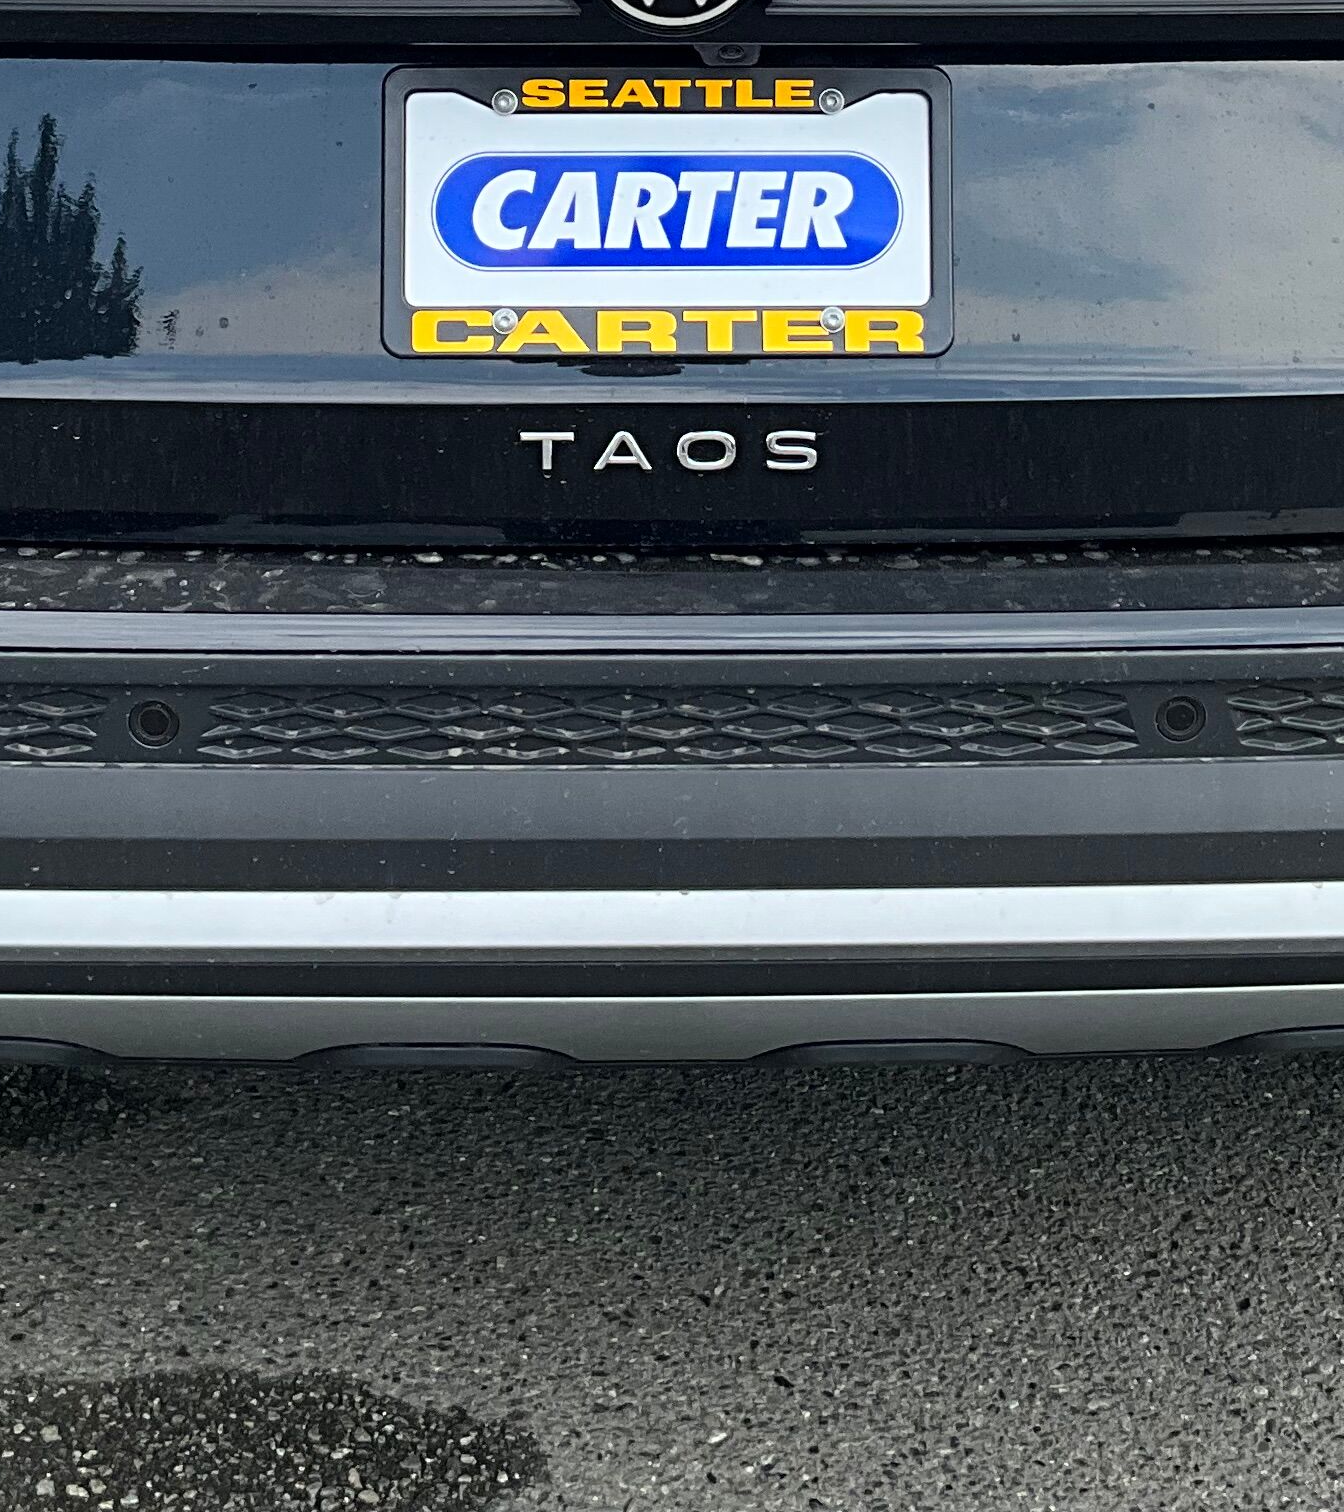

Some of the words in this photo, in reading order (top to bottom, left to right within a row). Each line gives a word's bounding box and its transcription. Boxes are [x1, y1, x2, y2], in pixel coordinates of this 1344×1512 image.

[520, 77, 815, 109] SEATTLE
[471, 169, 855, 251] CARTER
[410, 308, 926, 354] CARTER
[518, 429, 818, 471] TAOS
